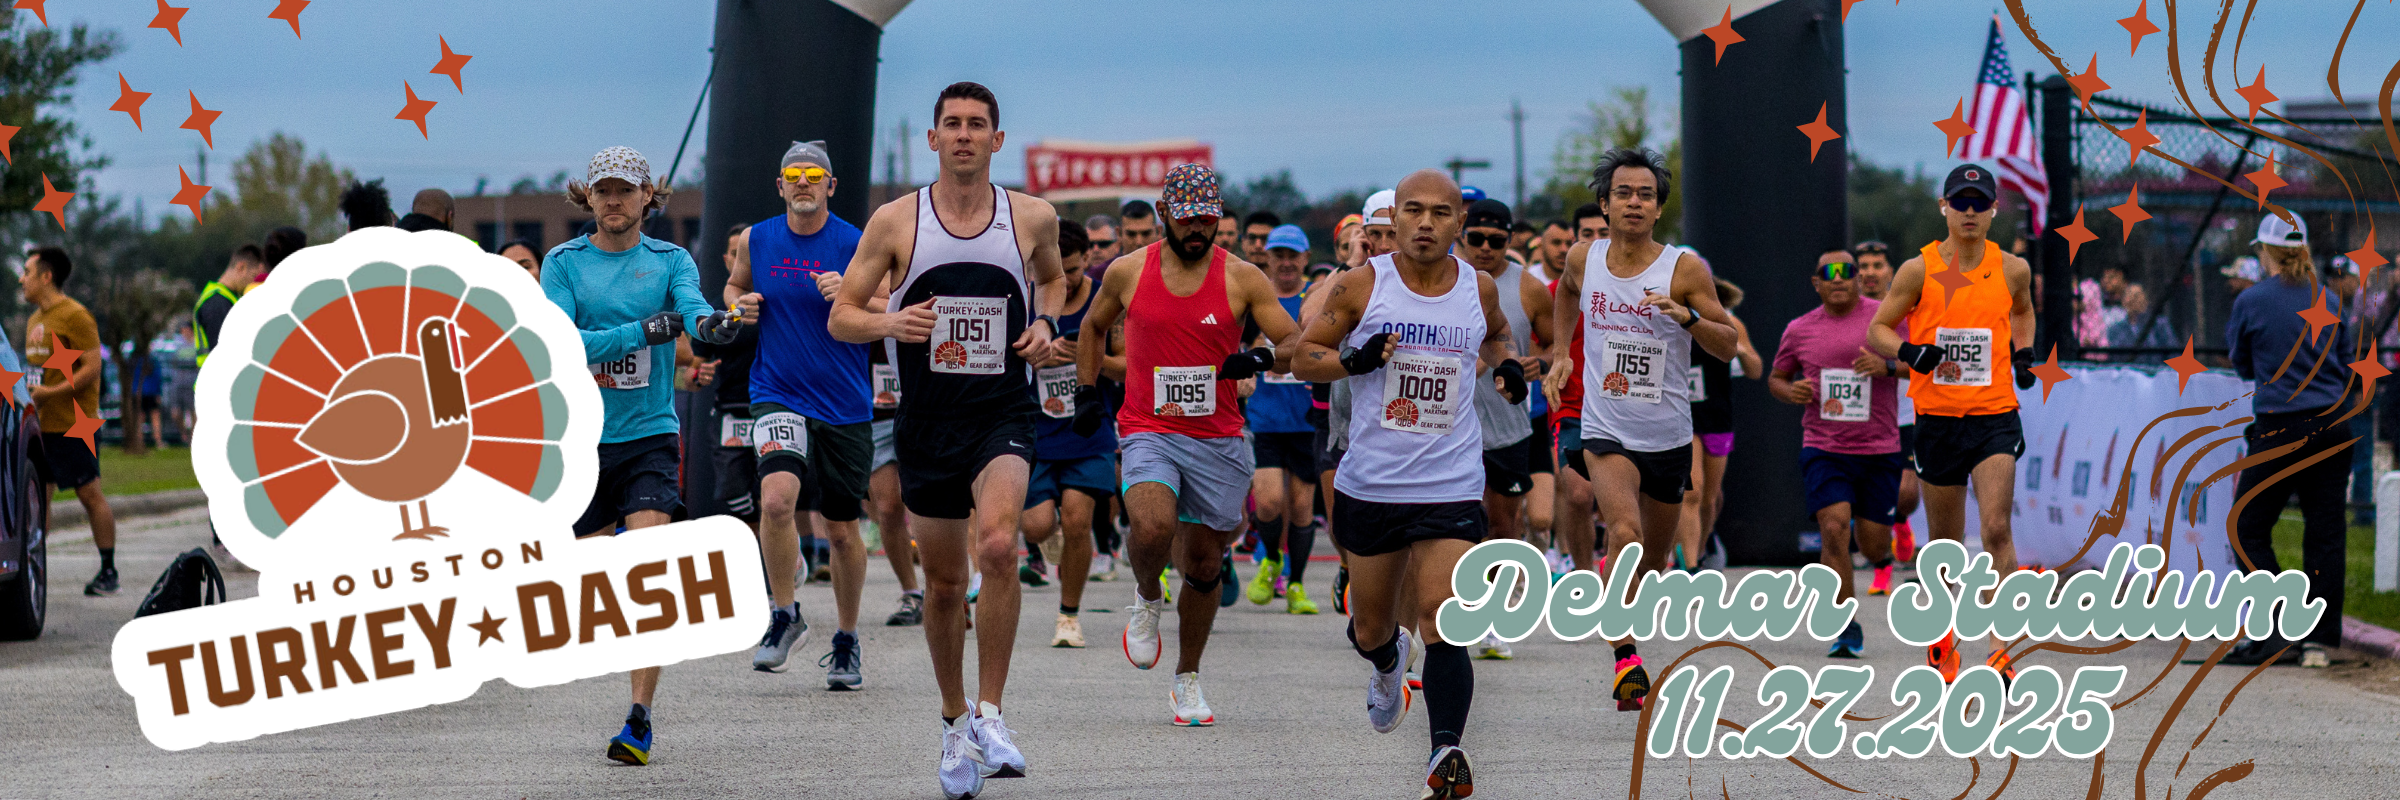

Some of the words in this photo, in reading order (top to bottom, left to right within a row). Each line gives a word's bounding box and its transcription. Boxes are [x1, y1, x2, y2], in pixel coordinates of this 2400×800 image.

[1034, 153, 1211, 188] Firesto
[783, 258, 821, 268] MIND
[937, 306, 973, 316] TURKEY
[978, 307, 1003, 316] DASH
[1609, 302, 1652, 320] LONG
[948, 318, 990, 342] 1051
[1592, 322, 1628, 332] RUNNING
[1630, 325, 1654, 336] CLUB
[1939, 334, 1965, 342] TURKEY
[1608, 341, 1637, 352] TURKEY
[1641, 346, 1663, 356] DASH
[1945, 344, 1981, 362] 1052
[601, 353, 636, 375] 1186
[1393, 361, 1429, 374] TURKEY
[1434, 367, 1457, 376] DASH
[1616, 353, 1651, 376] 1155
[1159, 374, 1188, 382] TURKEY
[1193, 373, 1212, 381] DASH
[1046, 379, 1077, 398] 1088
[1166, 384, 1205, 403] 1095
[1399, 374, 1447, 402] 1008
[1829, 383, 1861, 400] 1034
[733, 423, 754, 437] 119
[757, 419, 783, 429] TURKEY
[787, 418, 804, 428] DASH
[769, 425, 795, 441] 1151
